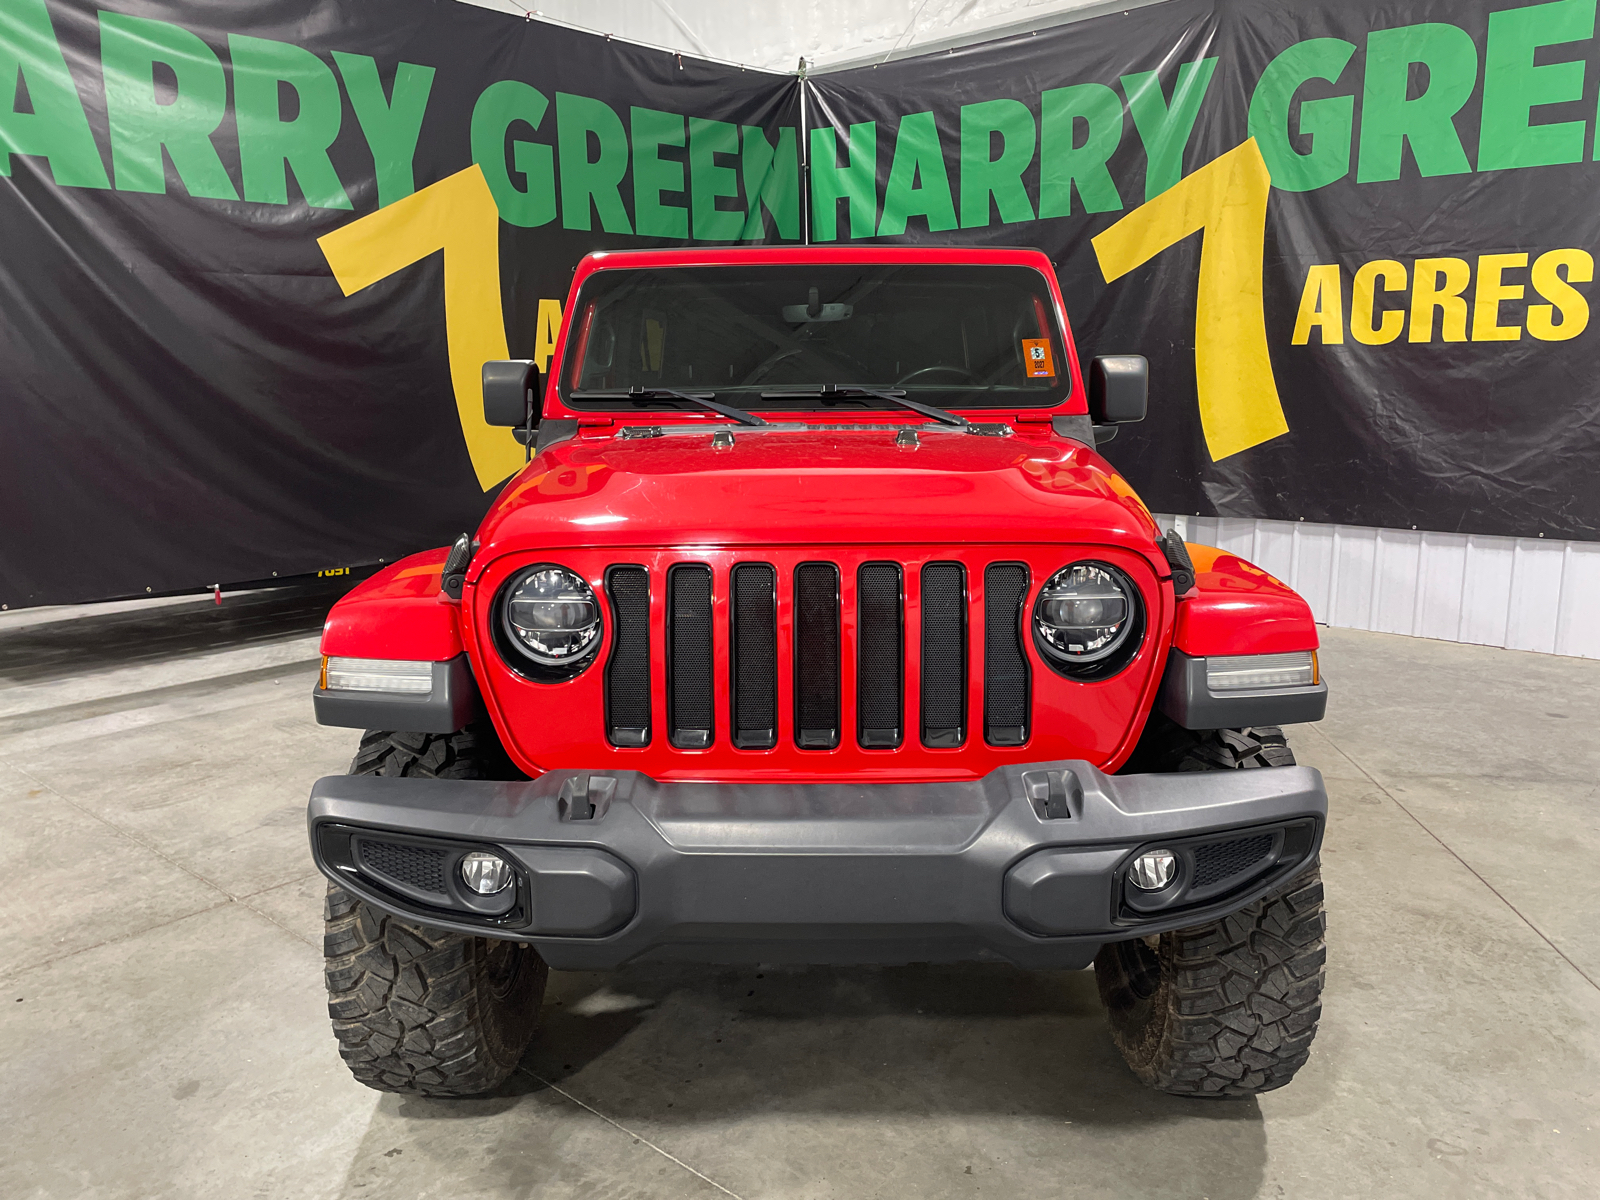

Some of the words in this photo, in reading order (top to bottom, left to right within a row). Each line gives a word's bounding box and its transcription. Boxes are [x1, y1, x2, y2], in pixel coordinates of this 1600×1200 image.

[471, 80, 799, 241] GREEN
[811, 56, 1219, 242] HARRY
[1248, 0, 1600, 193] GRE
[317, 163, 535, 493] 7
[1091, 136, 1289, 462] 7
[1291, 248, 1595, 346] ACRES
